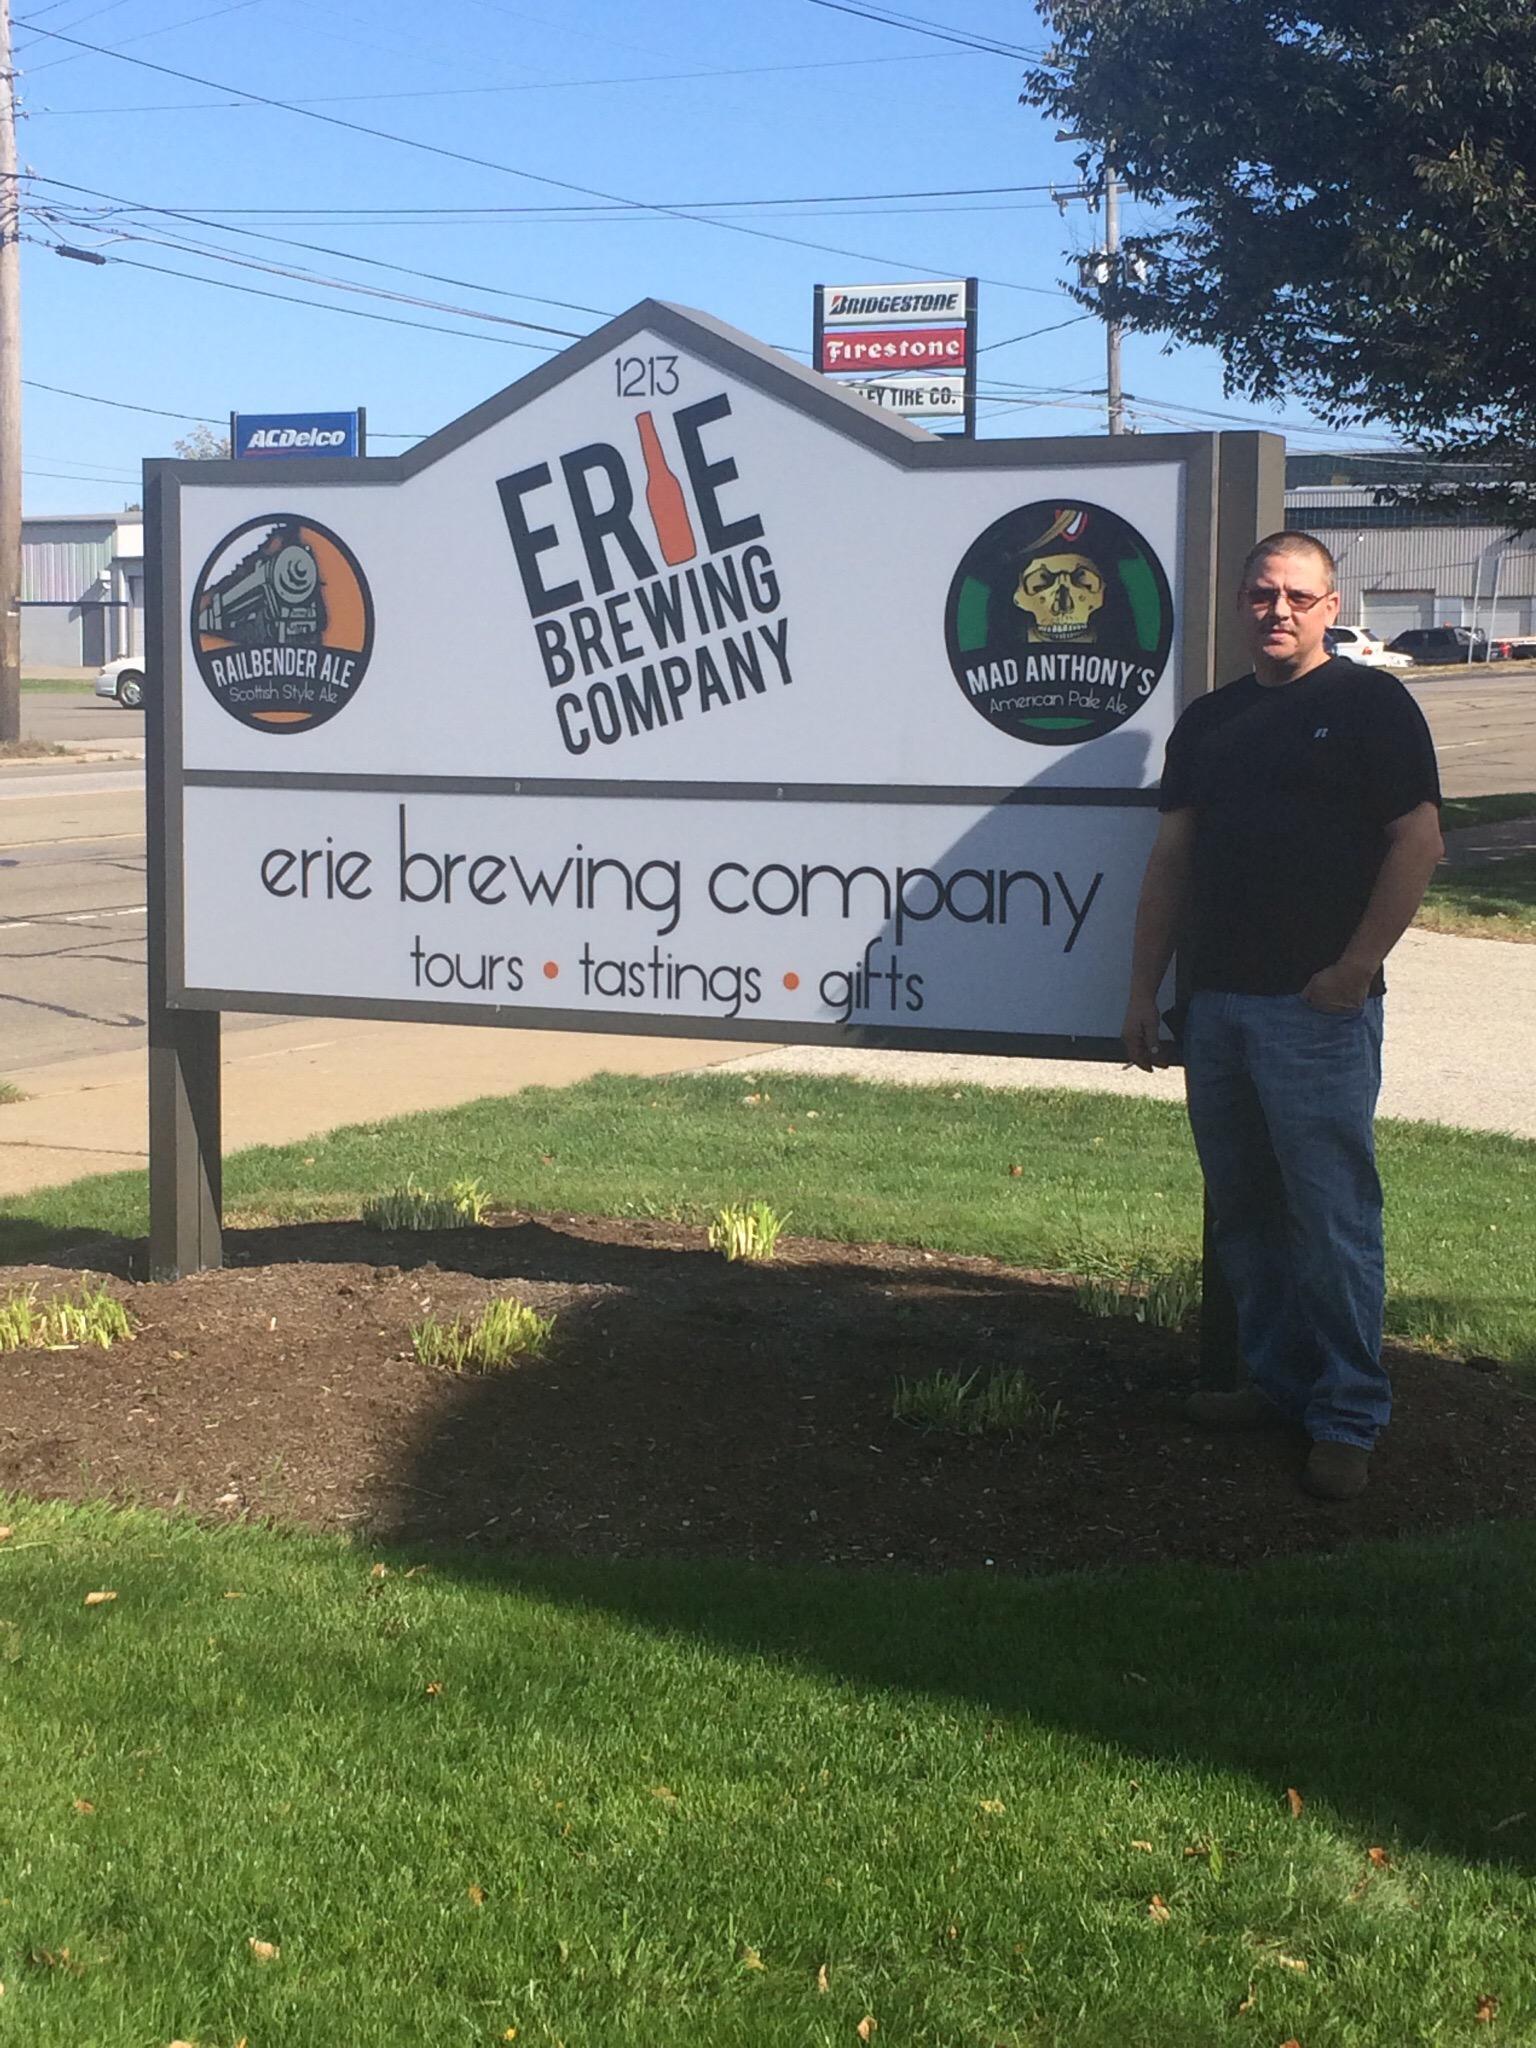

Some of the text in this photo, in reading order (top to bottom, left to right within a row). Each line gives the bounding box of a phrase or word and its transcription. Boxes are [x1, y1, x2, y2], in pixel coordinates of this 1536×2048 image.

[826, 340, 960, 363] Firestone
[614, 355, 680, 398] 1213
[891, 388, 924, 407] TIRE
[929, 386, 957, 405] CO.
[247, 427, 346, 448] ACDelco
[495, 392, 766, 620] ERIE
[534, 545, 781, 689] BREWING
[211, 648, 355, 689] RAILBENDER ALE
[556, 617, 793, 756] COMPANY
[965, 654, 1156, 696] MAD ANTHONY'S
[229, 680, 338, 705] Scottish Style Ale
[989, 688, 1129, 716] American Pale Ale
[261, 803, 1104, 953] erie brewing company
[410, 935, 924, 1023] tours tastings gifts
